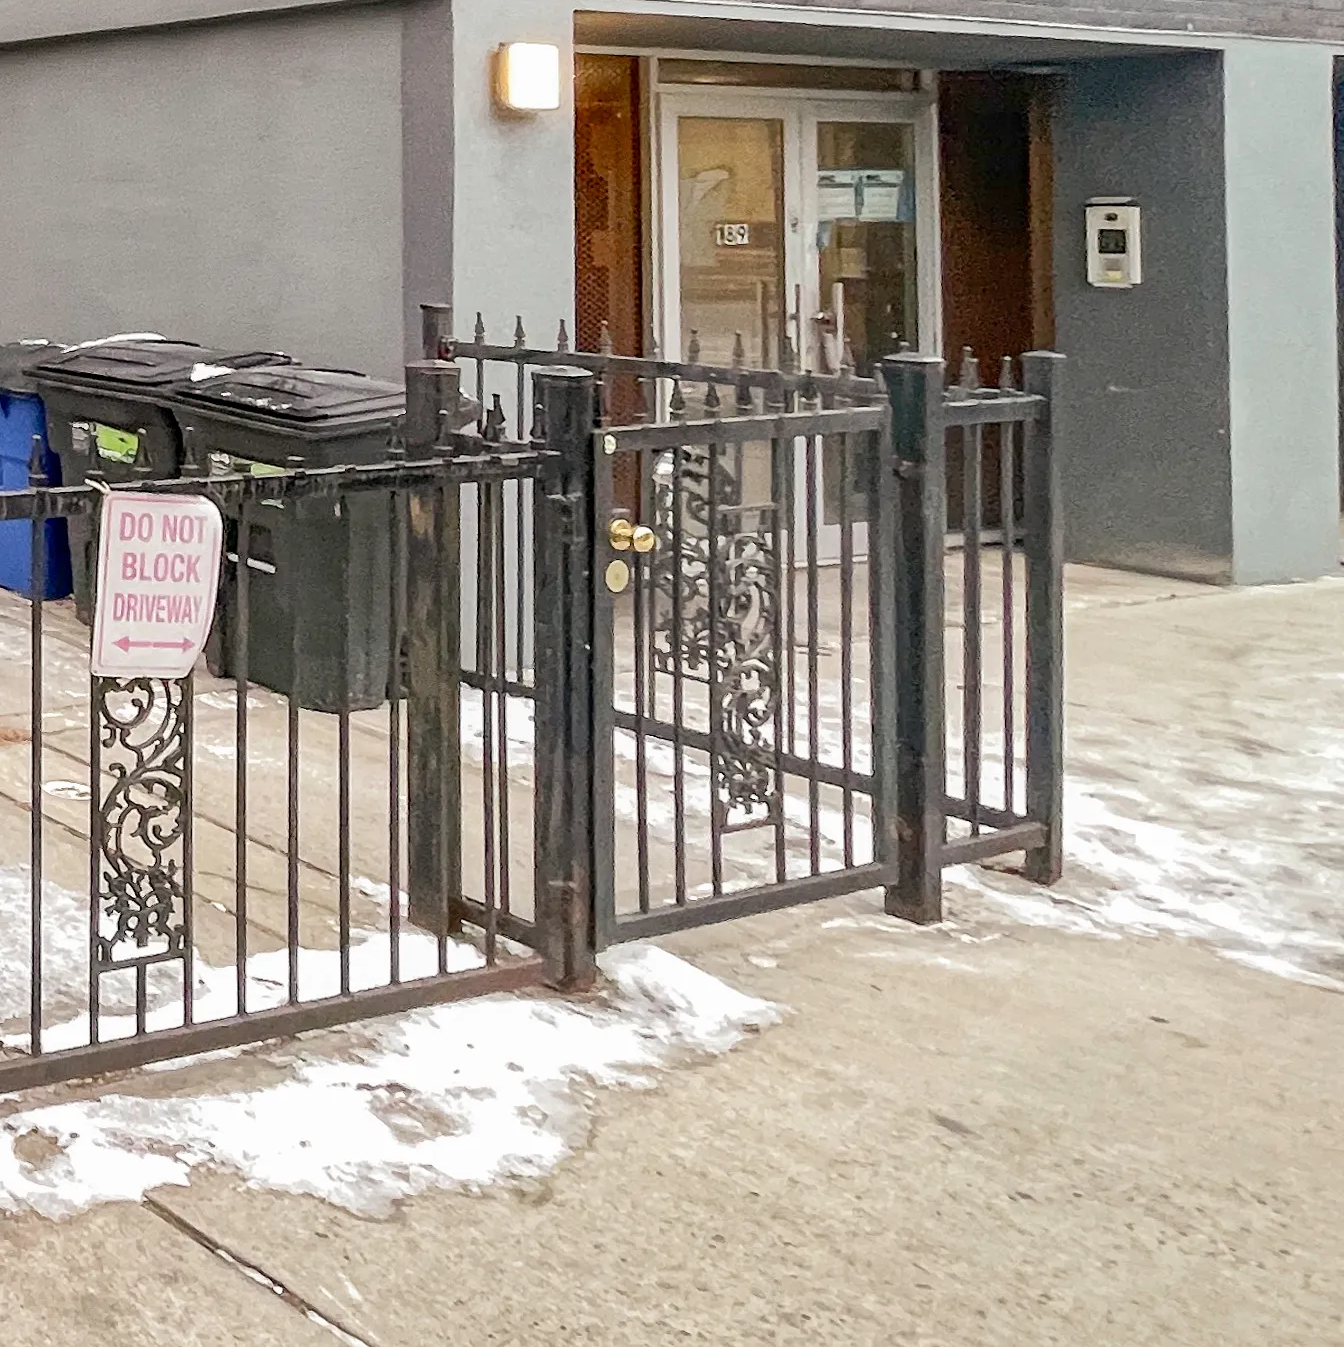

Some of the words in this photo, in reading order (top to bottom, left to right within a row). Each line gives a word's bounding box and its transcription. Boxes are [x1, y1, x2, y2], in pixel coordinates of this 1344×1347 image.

[717, 225, 747, 242] 189
[119, 512, 154, 542] DO
[162, 514, 208, 544] NOT
[121, 552, 200, 583] BLOCK
[112, 592, 203, 623] DRIVEWAY
